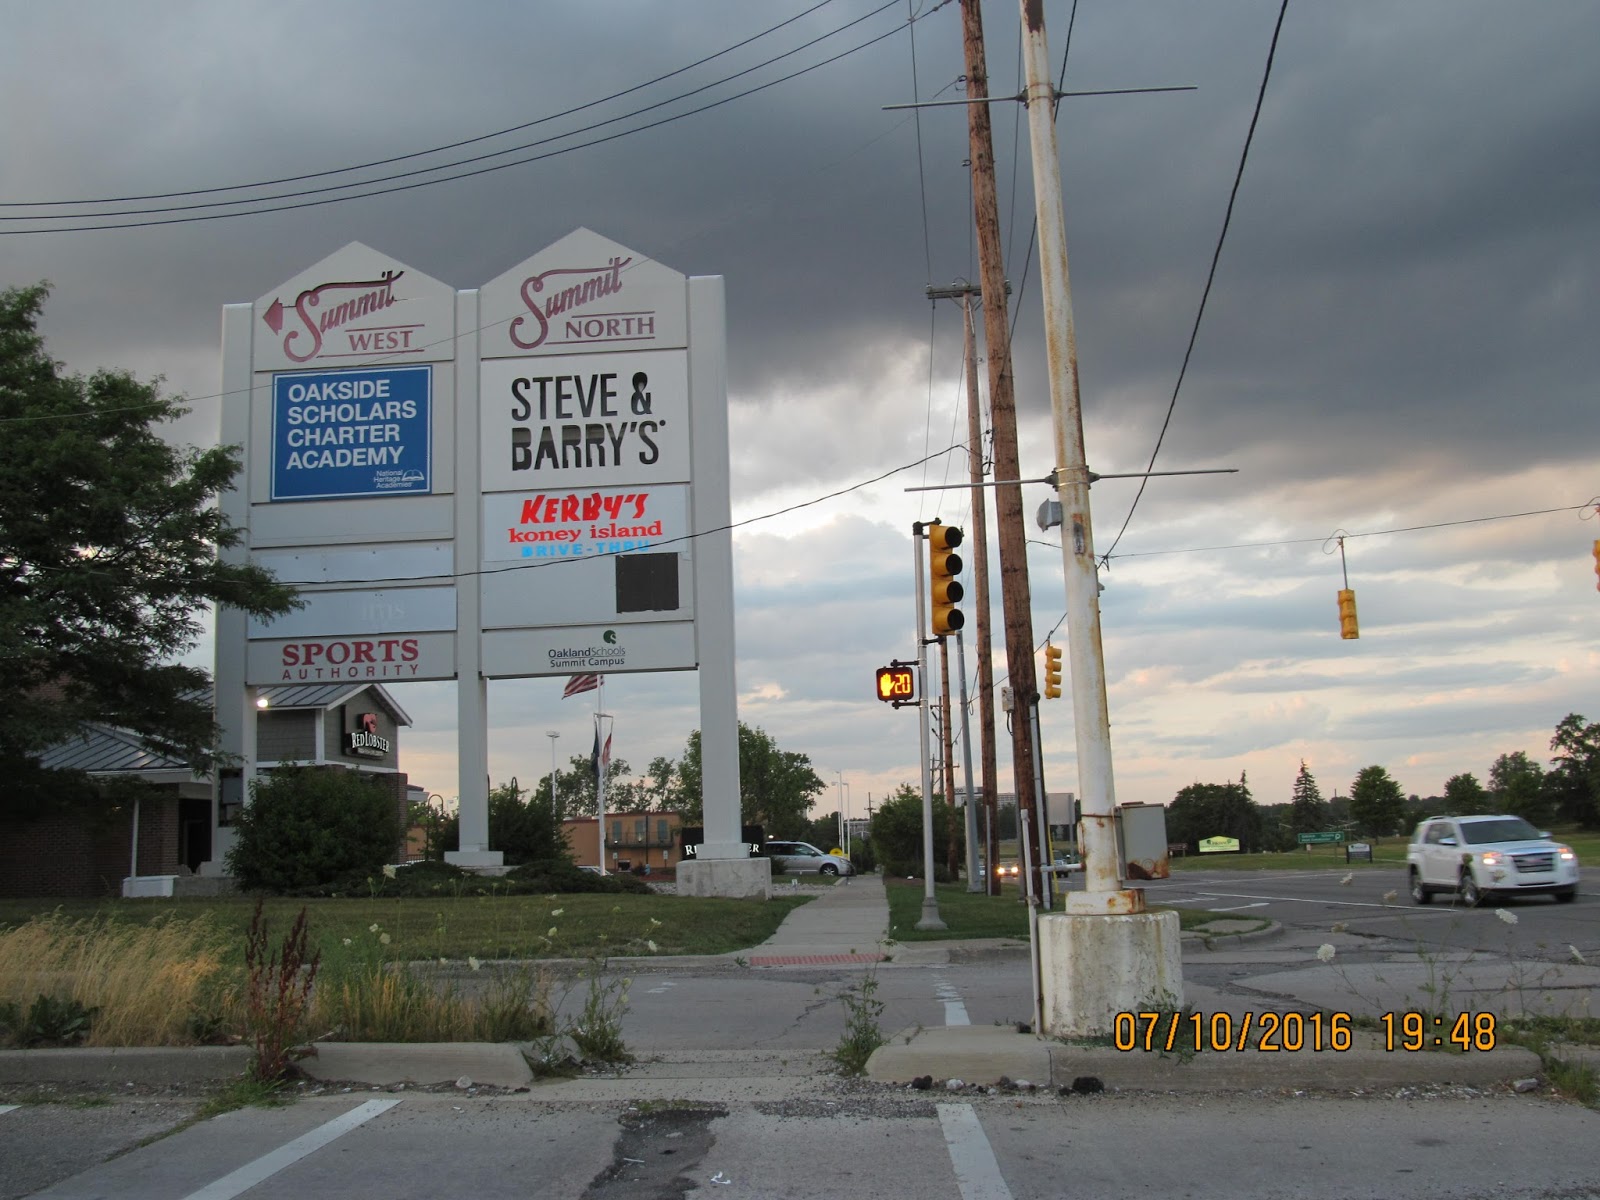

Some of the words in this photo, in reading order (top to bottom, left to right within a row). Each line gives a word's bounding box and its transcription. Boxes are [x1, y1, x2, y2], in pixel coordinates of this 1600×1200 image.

[508, 256, 633, 350] Summit
[283, 270, 405, 363] Summit
[565, 316, 655, 339] NORTH
[348, 330, 414, 351] WEST
[288, 379, 391, 403] OAKSIDE
[511, 373, 618, 421] STEVE
[630, 371, 653, 416] &
[287, 400, 417, 425] SCHOLARS
[287, 424, 401, 448] CHARTER
[511, 420, 660, 472] BARRY'S
[286, 446, 405, 470] ACADEMY
[376, 469, 404, 477] National
[520, 492, 649, 525] KERBY'S
[508, 527, 582, 543] koney
[589, 520, 663, 539] island
[521, 540, 650, 558] DRIVE-THRU
[282, 639, 419, 666] SPORTS
[550, 658, 586, 668] Summit
[588, 657, 625, 667] Campus
[282, 664, 419, 681] AUTHORITY
[894, 673, 911, 694] 20
